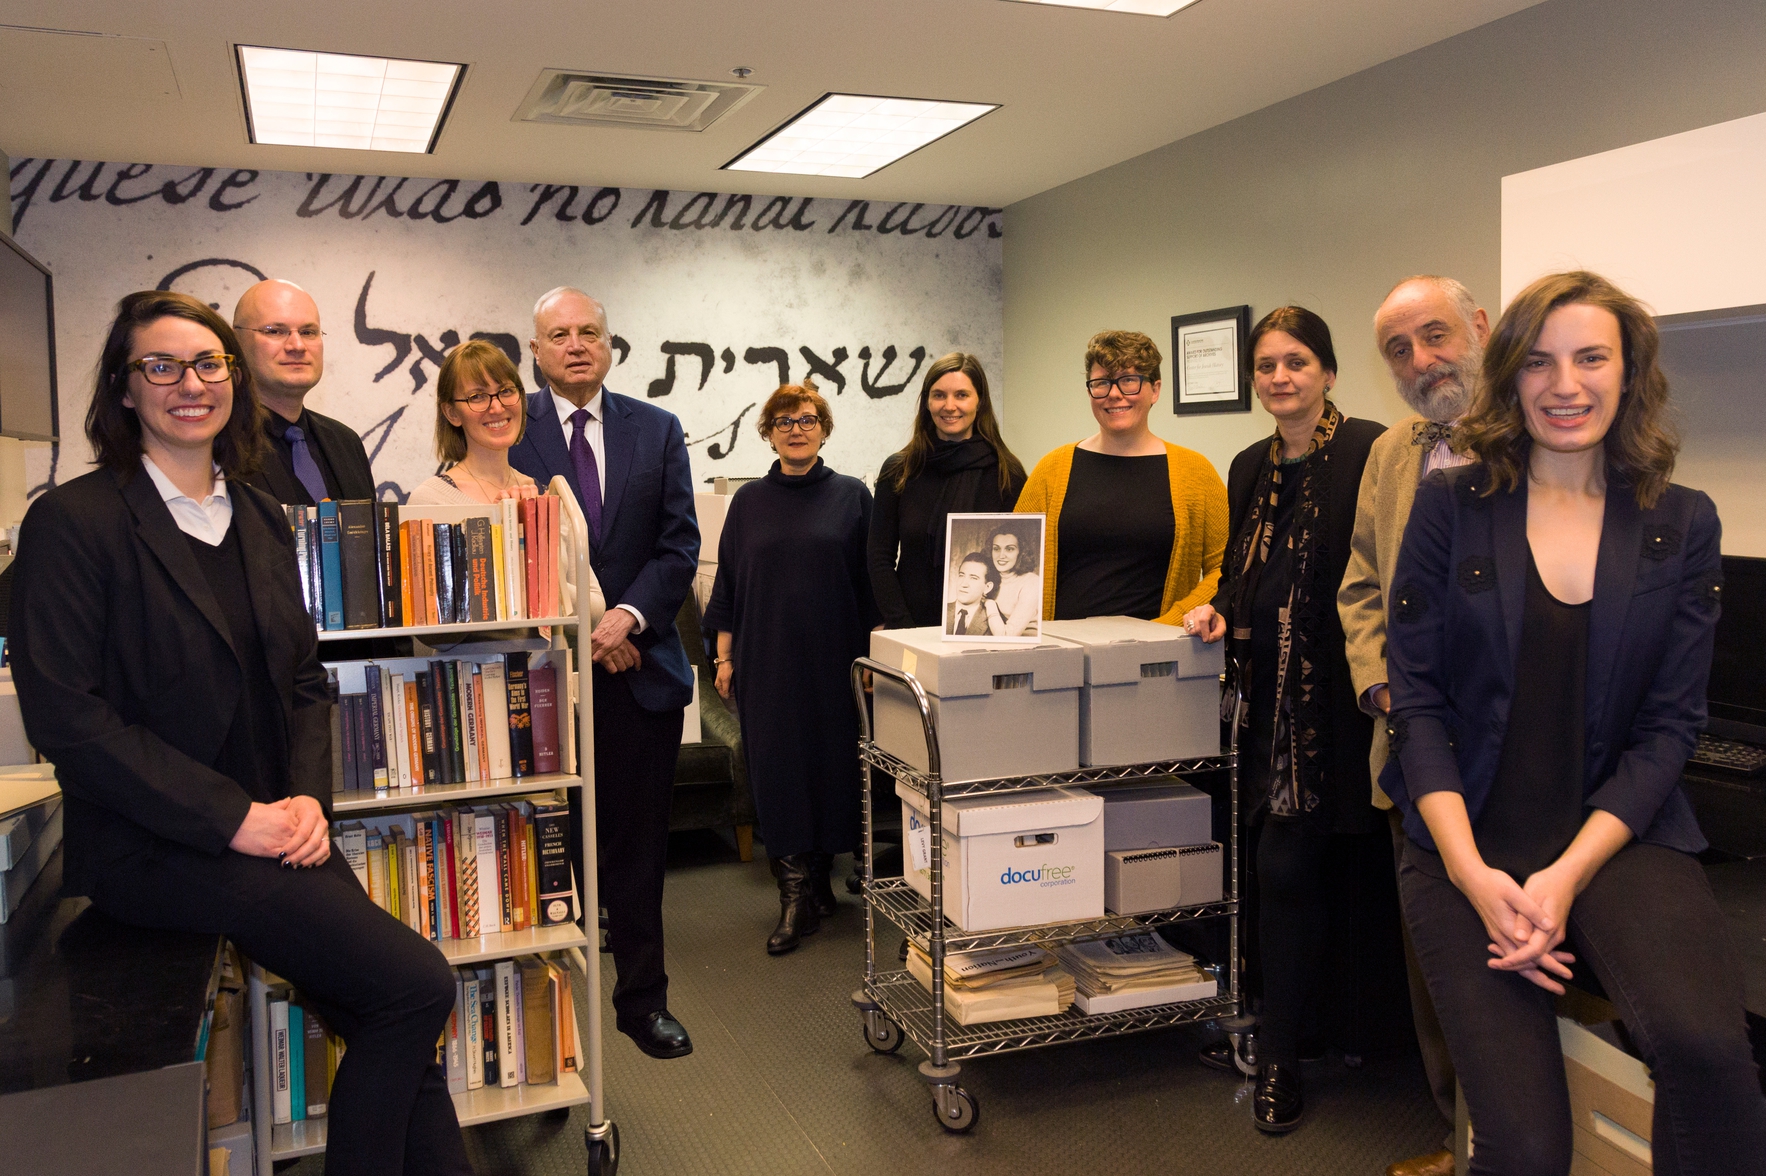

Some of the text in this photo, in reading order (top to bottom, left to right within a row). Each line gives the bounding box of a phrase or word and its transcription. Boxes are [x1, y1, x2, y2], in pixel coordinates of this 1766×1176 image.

[479, 558, 487, 588] Deutsche
[473, 574, 481, 596] Politik
[509, 703, 520, 711] World
[372, 717, 380, 740] GERMANY
[423, 709, 431, 728] HISTORY
[468, 713, 476, 746] GERMANY
[425, 829, 435, 900] NATIVE FASCISM
[1040, 878, 1076, 888] corporation
[961, 960, 996, 972] Nation
[1005, 951, 1036, 962] Youth
[471, 1014, 479, 1044] Change
